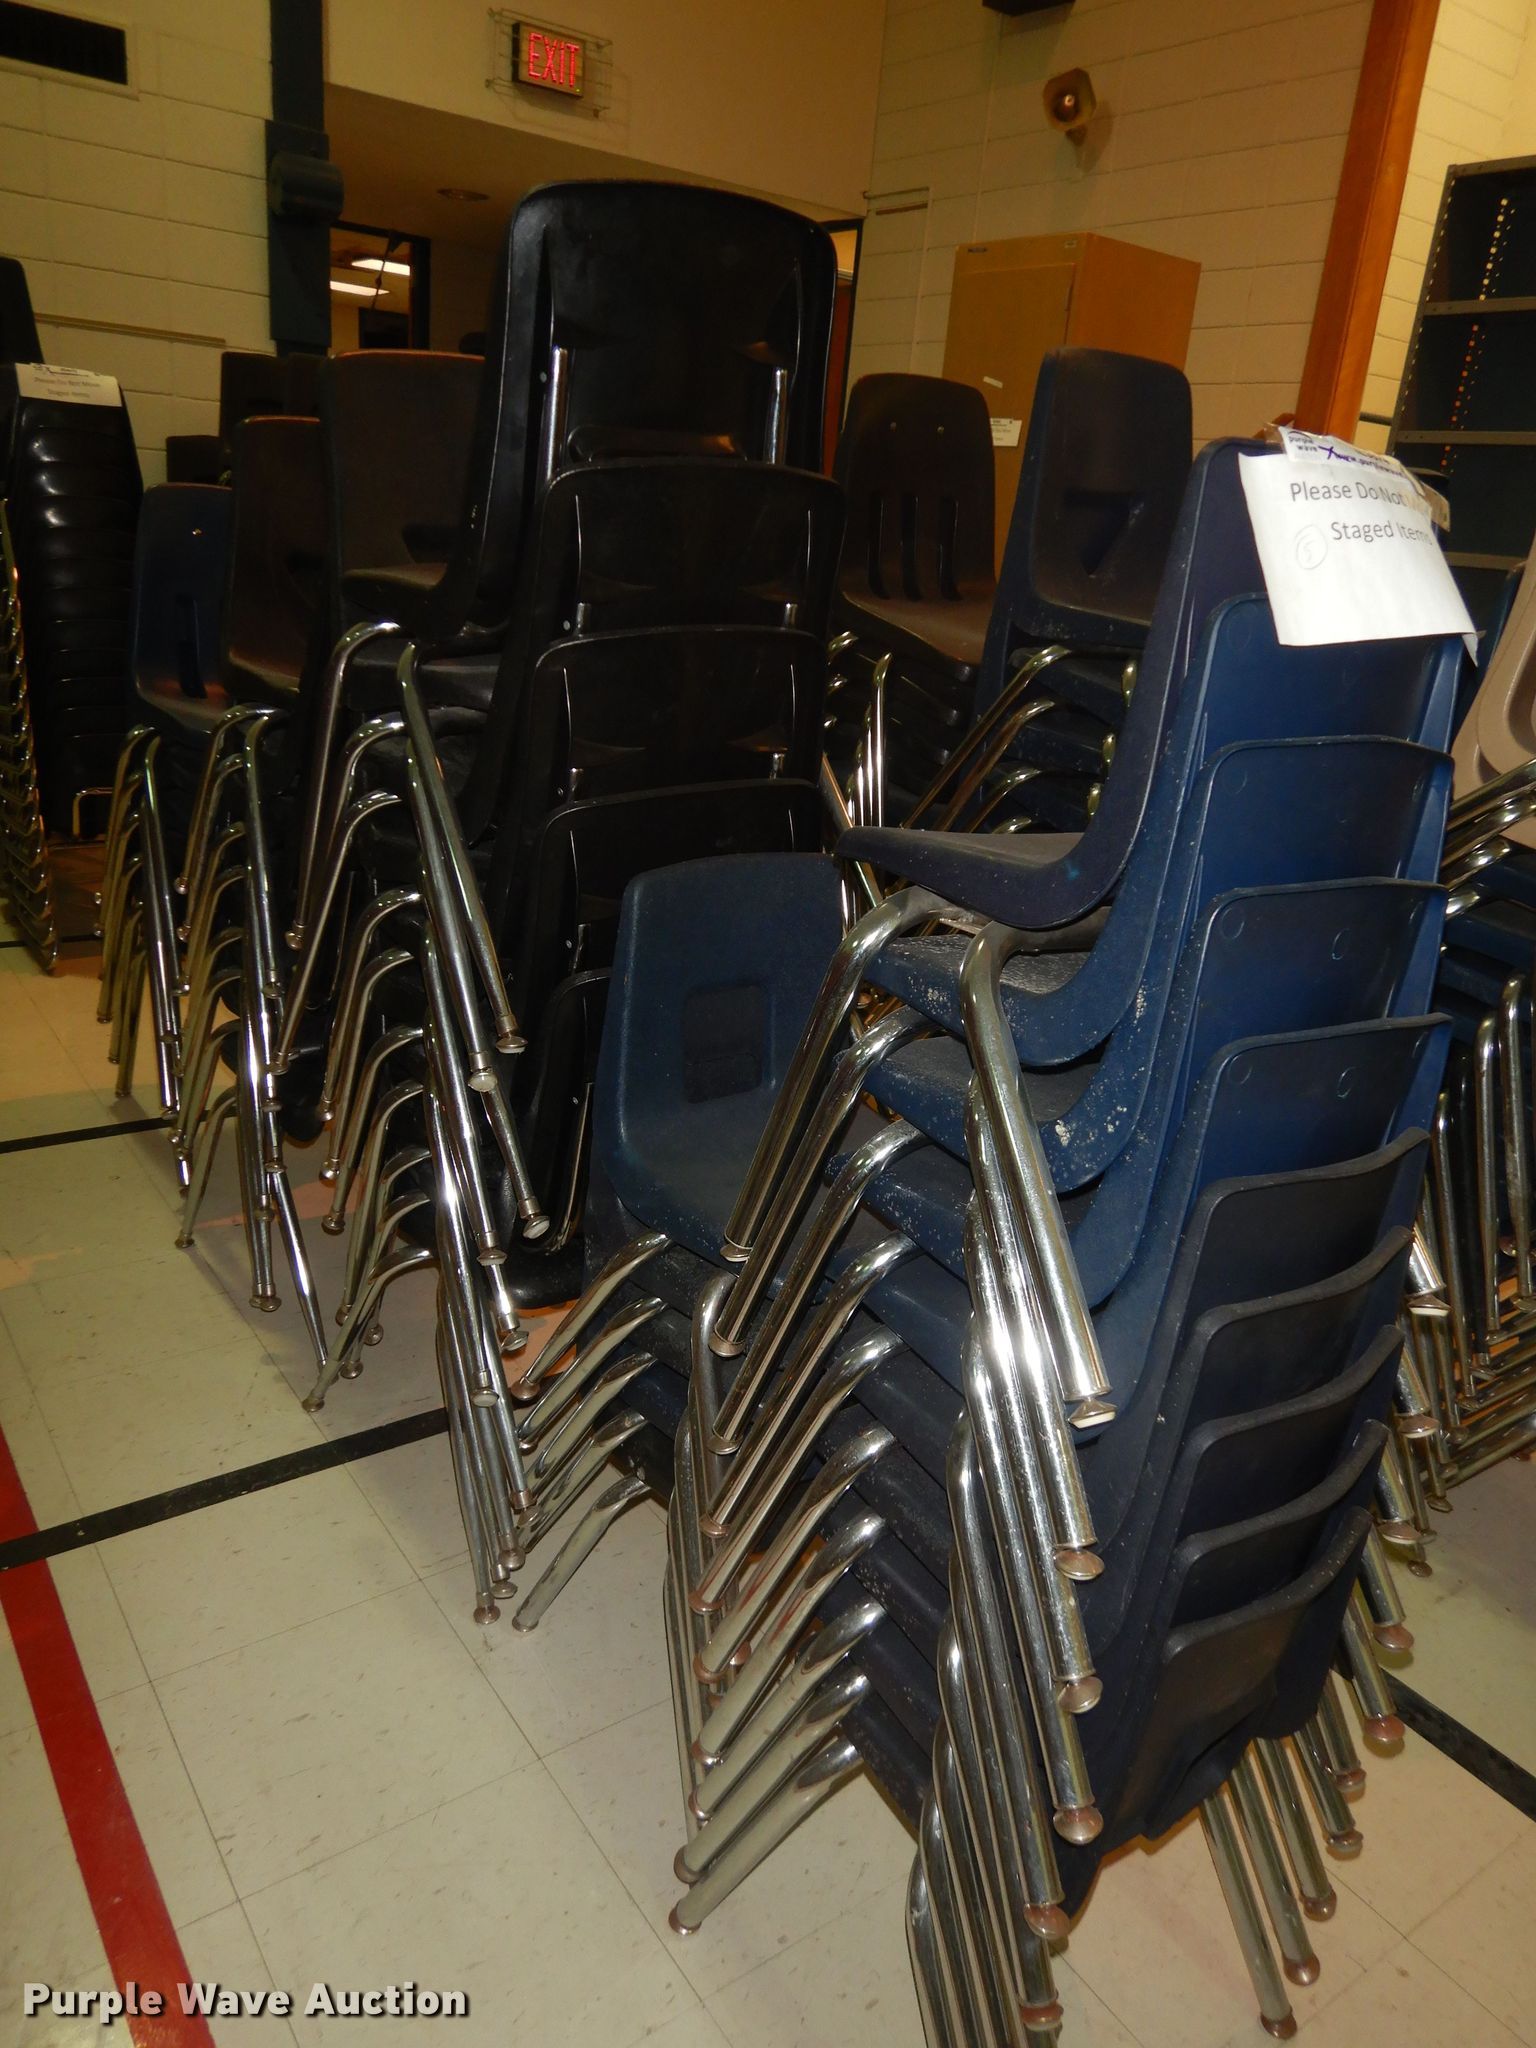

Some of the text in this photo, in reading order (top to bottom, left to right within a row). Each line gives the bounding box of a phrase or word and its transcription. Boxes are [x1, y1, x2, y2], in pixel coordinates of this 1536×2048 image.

[528, 32, 580, 88] EXIT
[1290, 481, 1352, 502] Please
[1355, 481, 1379, 500] Do
[1378, 486, 1409, 507] Not
[1330, 520, 1394, 543] Staged
